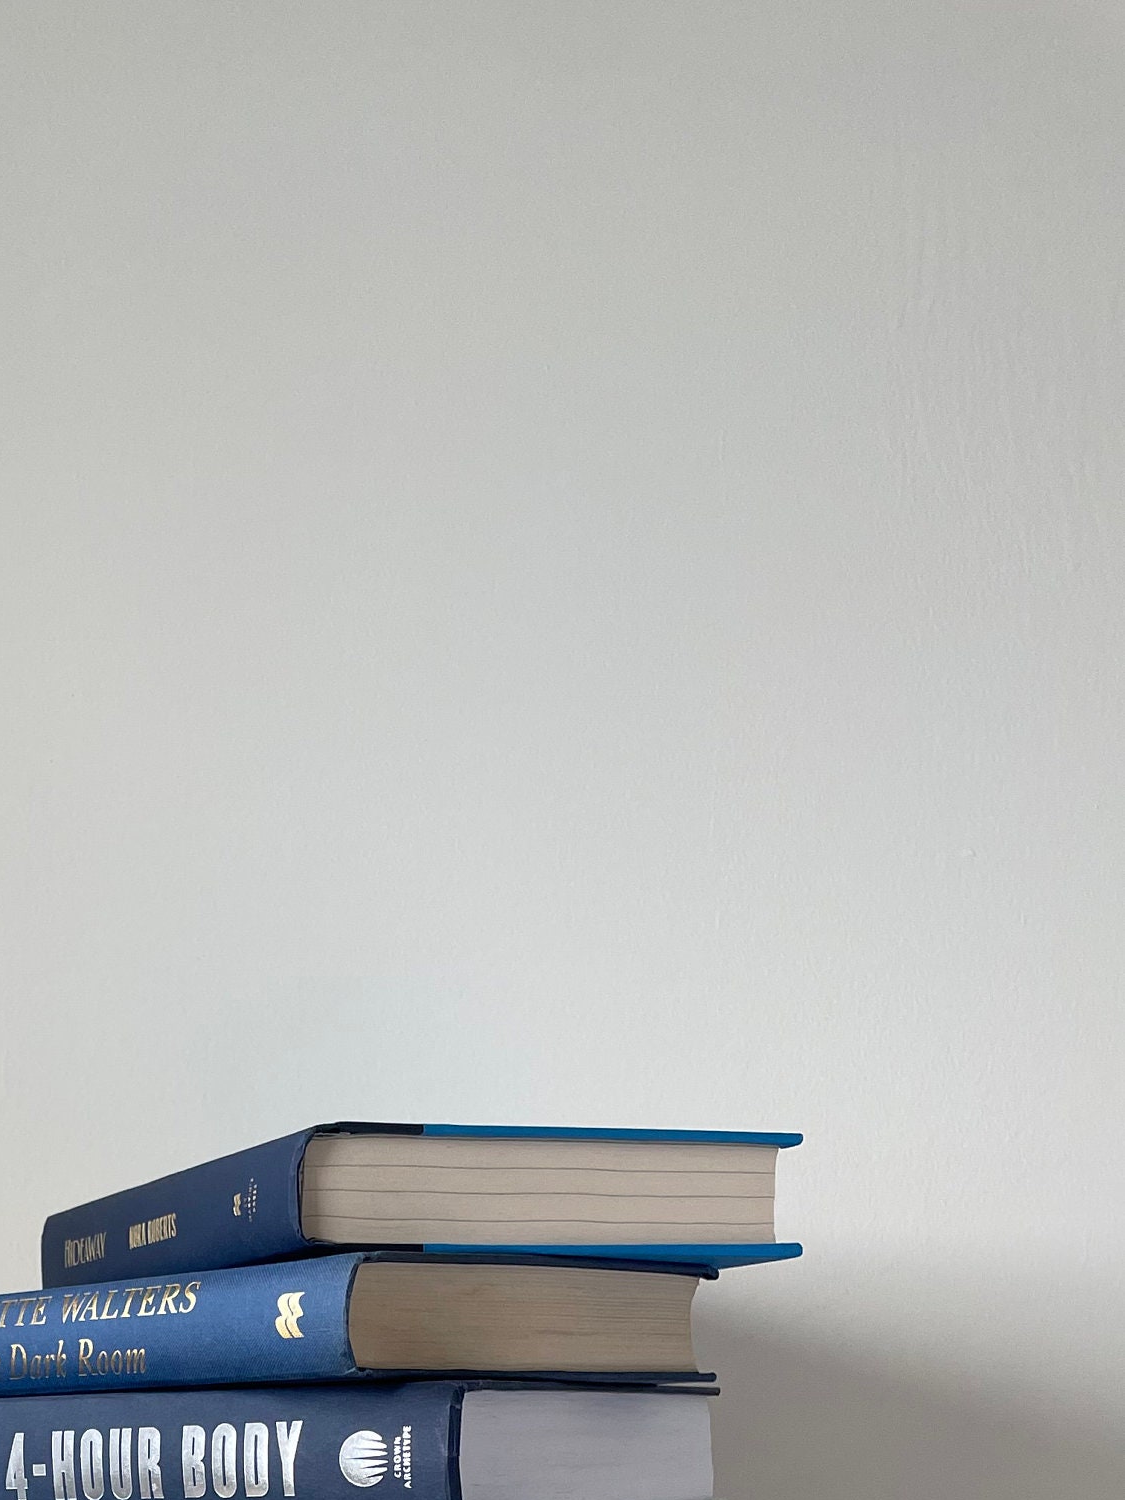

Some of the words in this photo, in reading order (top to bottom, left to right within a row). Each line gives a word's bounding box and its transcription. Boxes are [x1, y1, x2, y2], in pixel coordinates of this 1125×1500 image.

[64, 1231, 106, 1268] HIDEAWAY
[61, 1281, 202, 1324] WALTERS
[10, 1339, 67, 1380] Dark
[78, 1338, 146, 1376] Room
[6, 1427, 164, 1500] 4-HOUR
[182, 1420, 303, 1498] BODY
[402, 1426, 411, 1488] ARCHETYPE
